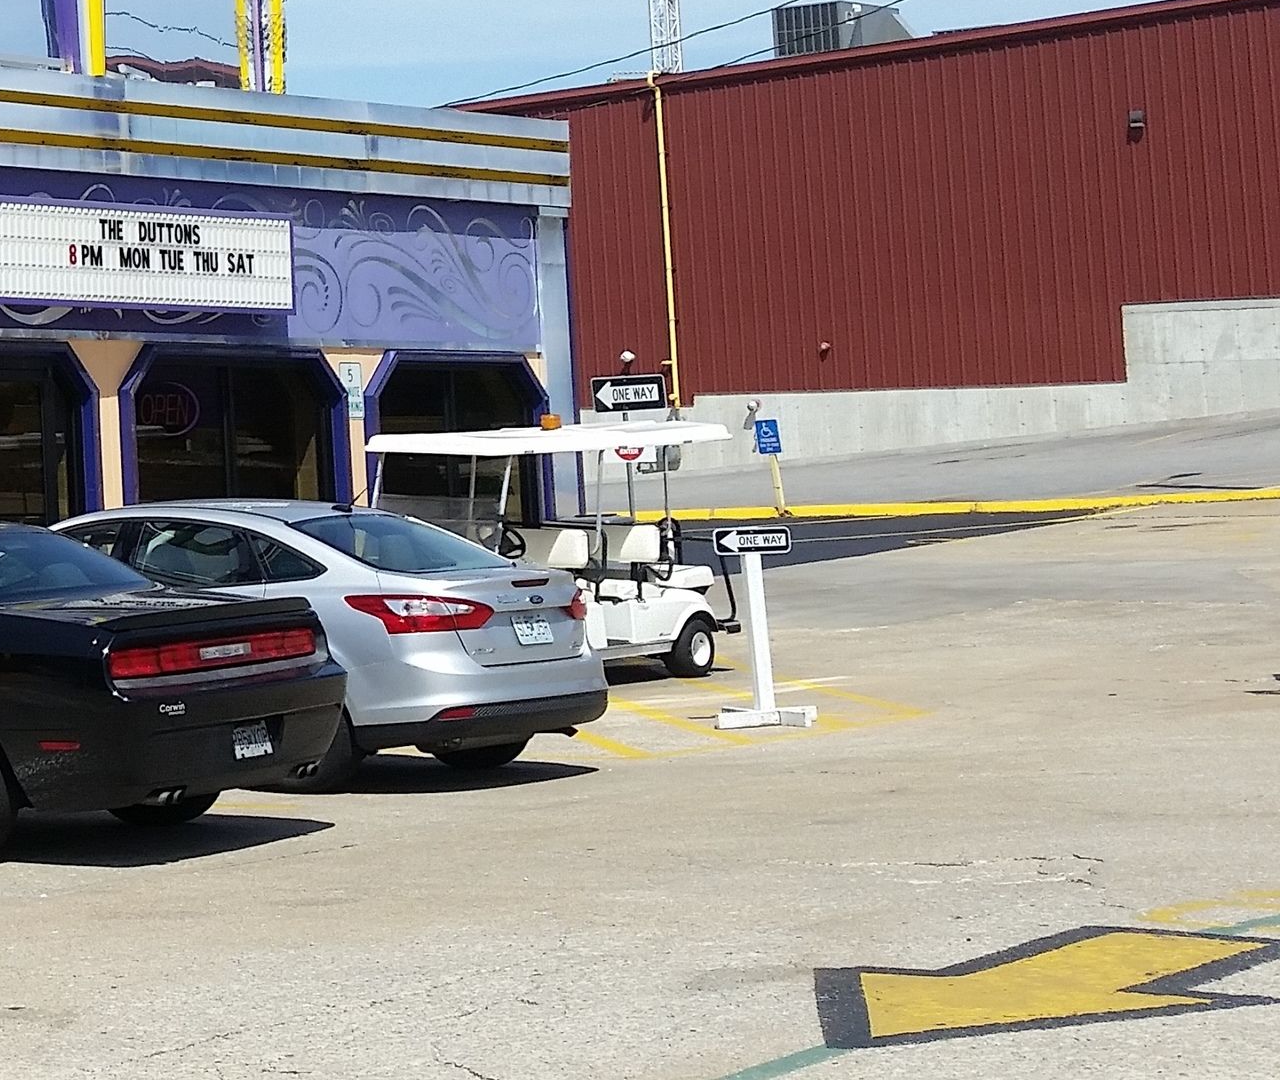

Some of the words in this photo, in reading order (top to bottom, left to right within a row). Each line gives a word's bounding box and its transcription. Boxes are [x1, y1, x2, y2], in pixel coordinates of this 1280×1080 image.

[99, 219, 124, 241] THE
[139, 221, 201, 246] DUTTONS
[69, 244, 77, 266] 8
[81, 245, 103, 267] PM
[119, 247, 151, 269] MON
[159, 249, 184, 271] TUE
[193, 251, 219, 272] THU
[227, 252, 254, 274] SAT
[347, 368, 354, 383] 5
[612, 387, 631, 401] ONE
[633, 386, 654, 400] WAY
[141, 393, 190, 425] OPEN
[738, 536, 759, 546] ONE
[763, 535, 783, 545] WAY
[159, 700, 186, 713] Corwin
